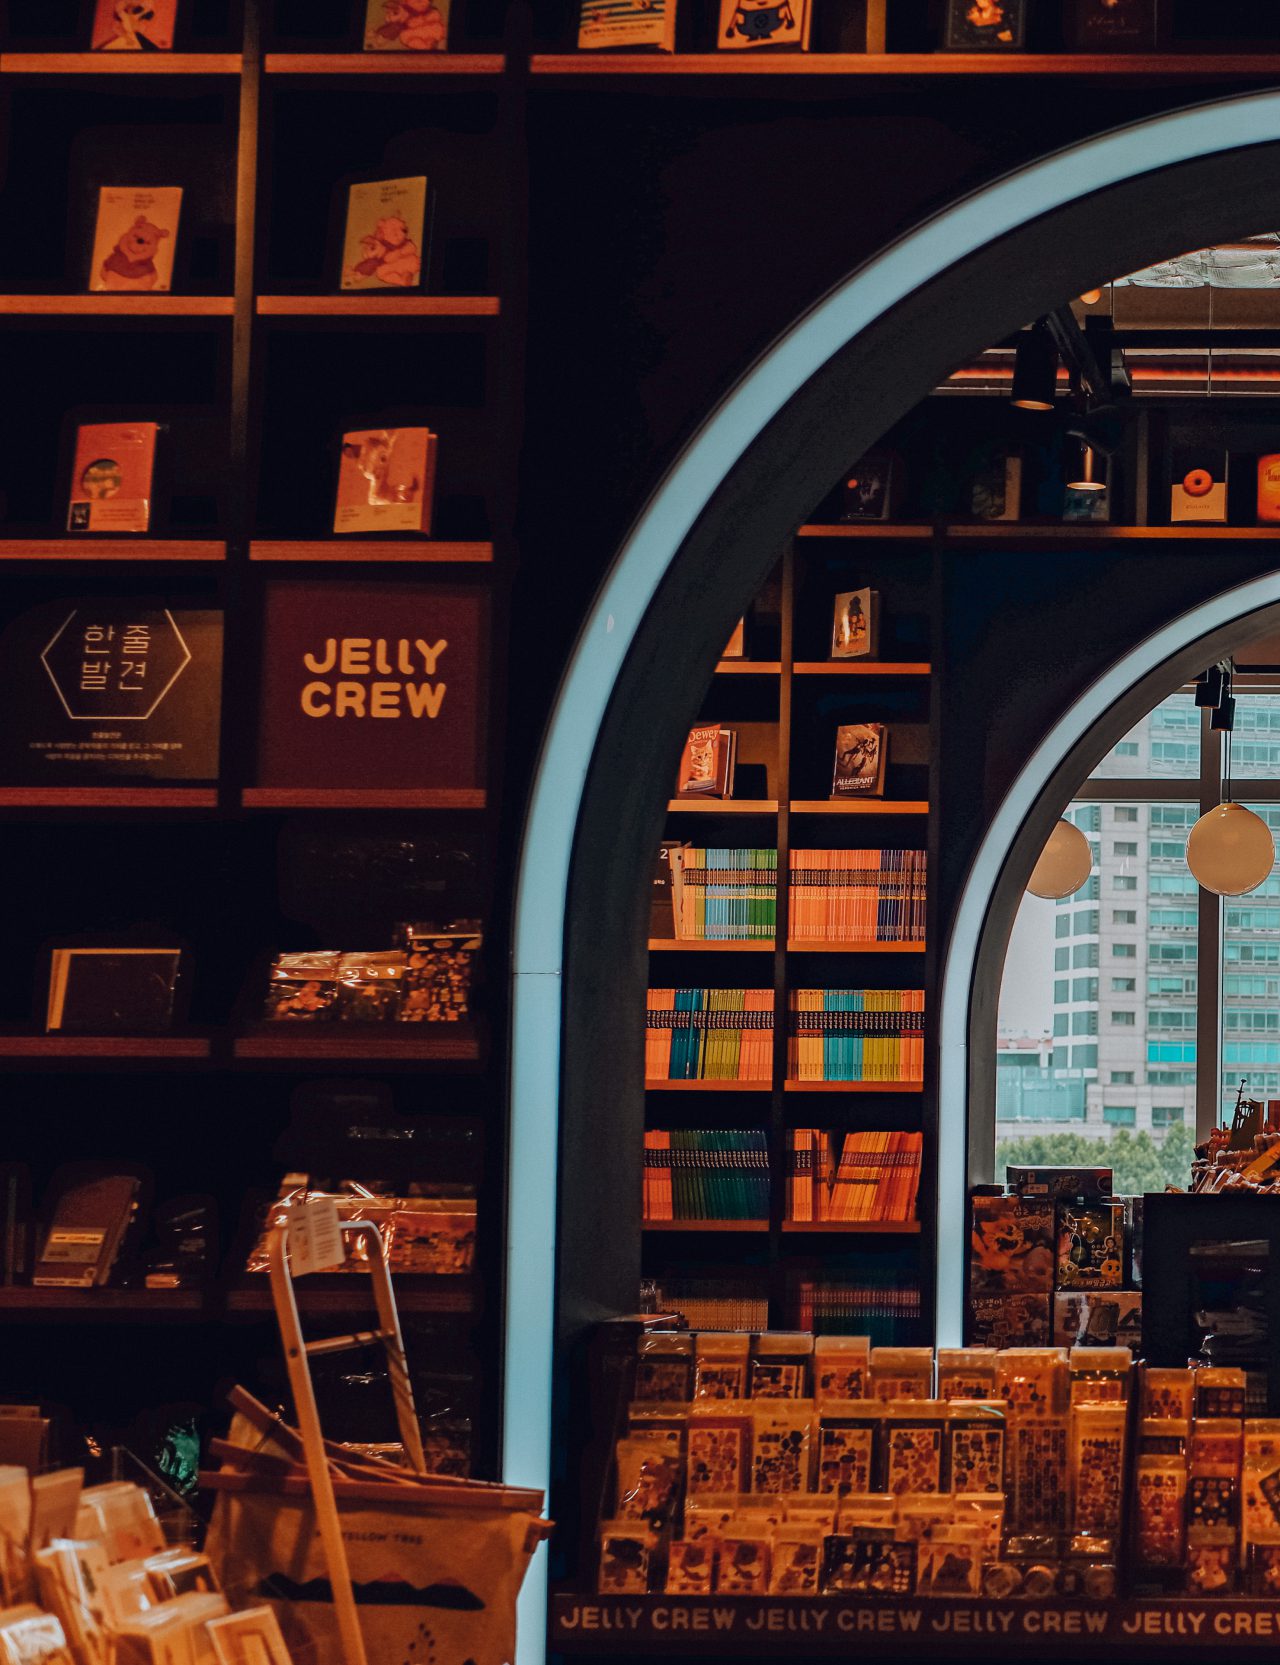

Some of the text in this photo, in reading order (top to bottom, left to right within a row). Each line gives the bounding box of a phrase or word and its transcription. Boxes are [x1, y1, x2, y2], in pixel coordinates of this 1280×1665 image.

[304, 638, 448, 675] JELLY
[301, 681, 447, 719] CREW
[688, 729, 719, 743] Dewey
[836, 776, 875, 786] ALLEGIANT
[560, 1607, 643, 1630] JELLY
[651, 1608, 735, 1630] CREW
[746, 1608, 829, 1631] JELLY
[838, 1609, 920, 1632] CREW
[932, 1610, 1015, 1633] JELLY
[1023, 1611, 1108, 1633] CREW
[1122, 1611, 1206, 1634] JELLY
